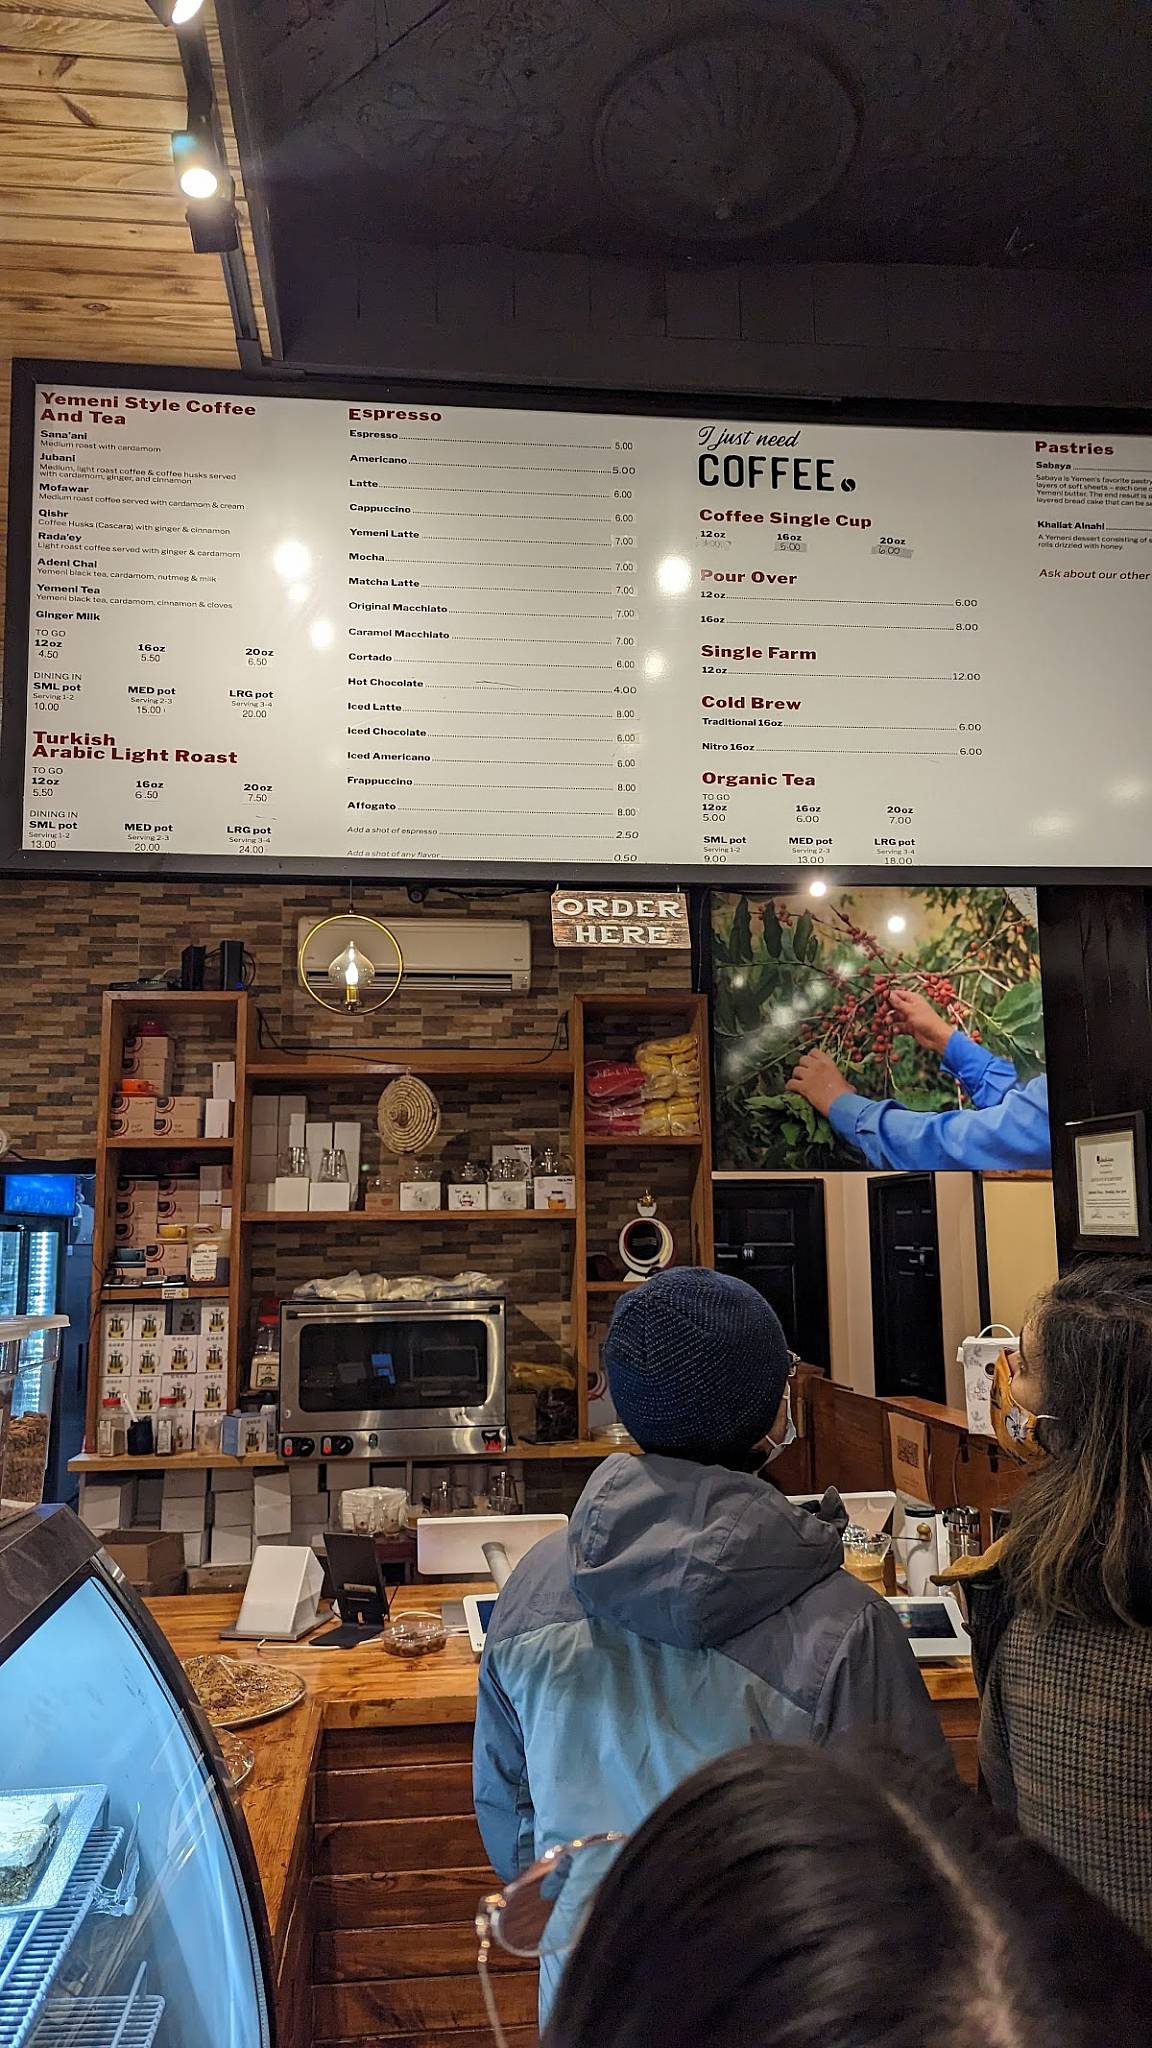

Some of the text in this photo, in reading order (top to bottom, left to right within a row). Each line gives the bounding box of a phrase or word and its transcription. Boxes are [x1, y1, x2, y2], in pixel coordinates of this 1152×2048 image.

[41, 392, 255, 415] Yemeni Style Coffee
[40, 409, 125, 424] And Tea
[349, 409, 441, 421] Espresso
[40, 430, 87, 439] Sana'ani
[350, 430, 632, 450] Espresso 5.00
[708, 427, 755, 451] just
[755, 430, 801, 448] need
[1036, 441, 1113, 455] Pastries
[40, 453, 75, 461] Jubani
[350, 455, 407, 464] Americano
[699, 454, 834, 491] COFFEE
[1036, 462, 1071, 470] Sabaya
[40, 483, 89, 492] Mofawar
[39, 509, 68, 517] Qishr
[350, 504, 633, 522] Cappuccino 6.00
[700, 509, 871, 529] Coffee Single Cup
[38, 532, 81, 542] Rada'ey
[350, 529, 388, 538] Yemeni
[391, 530, 419, 538] Latte
[38, 558, 97, 568] Adeni Chai
[349, 553, 633, 571] Mocha 7.00
[701, 570, 797, 584] Pour Over
[1039, 569, 1060, 577] Ask
[1064, 570, 1095, 578] about
[37, 584, 100, 594] Yemeni Tea
[392, 579, 419, 587] Latte
[616, 586, 634, 594] 7.00
[349, 602, 634, 618] Original Macchiato 7.00
[956, 599, 977, 607] 6.00
[36, 611, 73, 620] Ginger
[956, 623, 978, 631] 8.00
[349, 629, 633, 645] Caramel Macchiato 7.00
[35, 639, 62, 647] 12oz
[138, 644, 165, 652] 16oz
[701, 645, 816, 660] Single Farm
[39, 650, 58, 658] 4.50
[141, 654, 160, 662] 5.50
[349, 653, 634, 668] Cortado 6.00
[34, 672, 69, 680] DINING
[34, 682, 59, 690] SML
[63, 684, 80, 694] pot
[348, 678, 637, 694] Hot Chocolate 4.00
[35, 702, 266, 718] 10.00 15.00 20.00
[348, 703, 370, 712] Iced
[702, 696, 801, 710] Cold Brew
[702, 718, 756, 726] Traditional
[33, 731, 115, 747] Turkish
[348, 727, 635, 742] Iced Chocolate 6.00
[32, 745, 237, 763] Arabic Light Roast
[373, 753, 430, 761] Americano
[618, 759, 635, 767] 6.00
[348, 777, 412, 788] Frappuccino
[703, 772, 815, 787] Organic Tea
[135, 791, 158, 799] 6.50
[248, 794, 267, 802] 7.50
[348, 802, 635, 816] Affogato 8.00
[557, 899, 683, 918] ORDER
[576, 925, 668, 944] HERE
